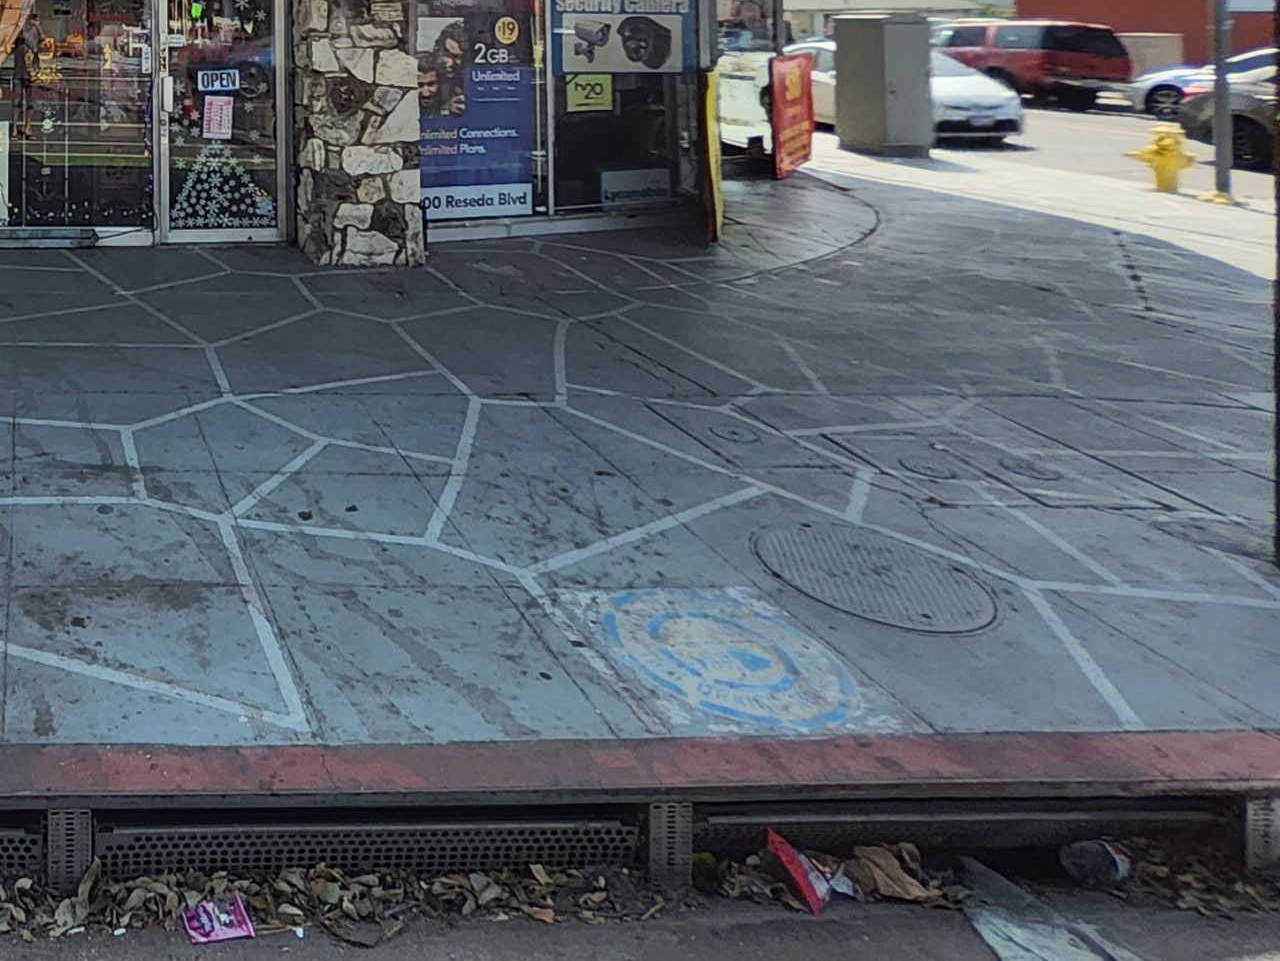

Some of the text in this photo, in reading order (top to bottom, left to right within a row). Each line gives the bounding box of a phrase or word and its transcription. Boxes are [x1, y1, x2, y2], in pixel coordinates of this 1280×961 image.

[474, 43, 509, 64] 2GB
[201, 71, 237, 89] OPEN
[472, 70, 520, 82] Unlimited
[459, 127, 520, 139] Connections.
[445, 194, 494, 209] Reseda
[498, 192, 528, 206] Blvd
